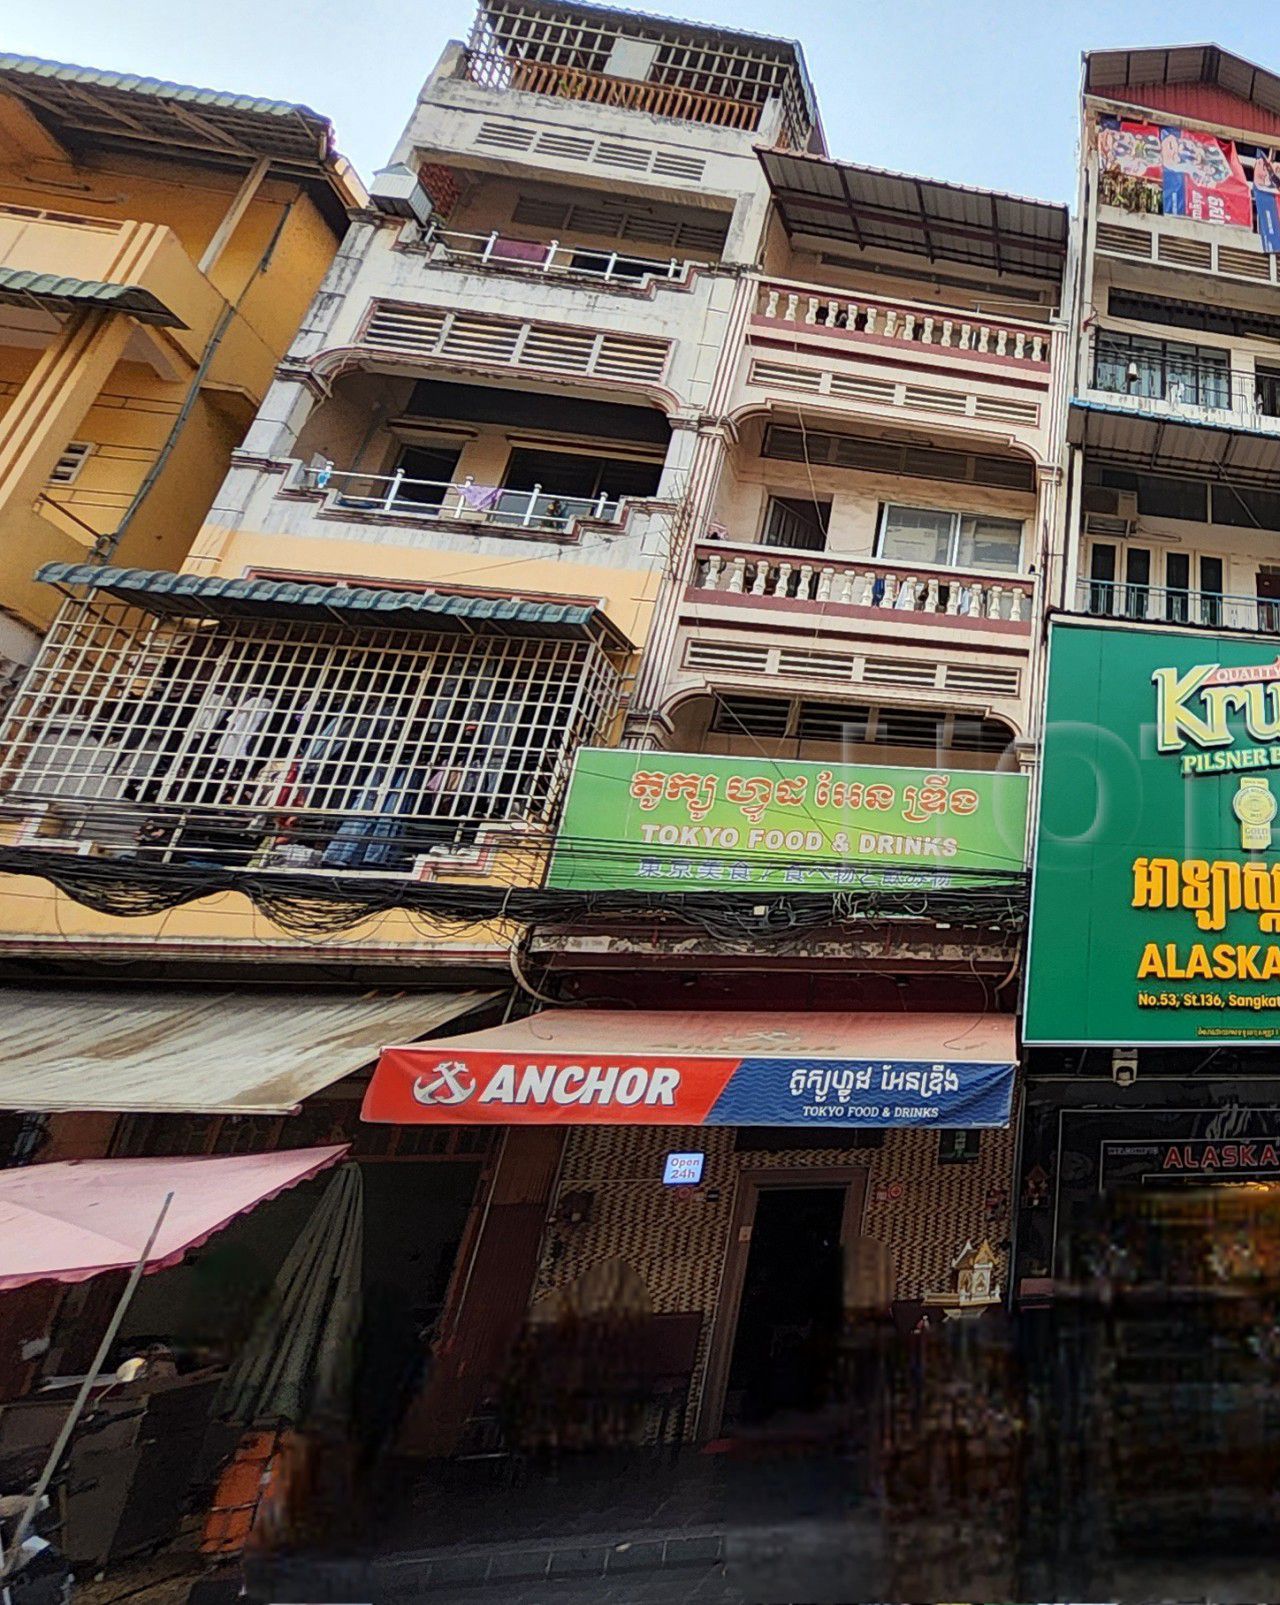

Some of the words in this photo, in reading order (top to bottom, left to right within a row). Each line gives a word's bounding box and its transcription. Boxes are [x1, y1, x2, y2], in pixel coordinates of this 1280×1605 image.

[1182, 748, 1269, 774] PILSNER
[641, 824, 739, 849] TOKYO
[748, 829, 824, 852] FOOD
[832, 832, 850, 853] &
[859, 833, 959, 858] DRINKS
[1138, 993, 1180, 1008] No.53,
[1183, 993, 1225, 1009] St.136,
[478, 1064, 681, 1105] ANCHOR
[803, 1106, 844, 1118] TOKYO
[847, 1106, 880, 1118] FOOD
[882, 1106, 891, 1118] &
[894, 1107, 940, 1118] DRINKS
[670, 1157, 700, 1169] Open
[1163, 1145, 1280, 1170] ALASKA
[670, 1169, 696, 1179] 24h
